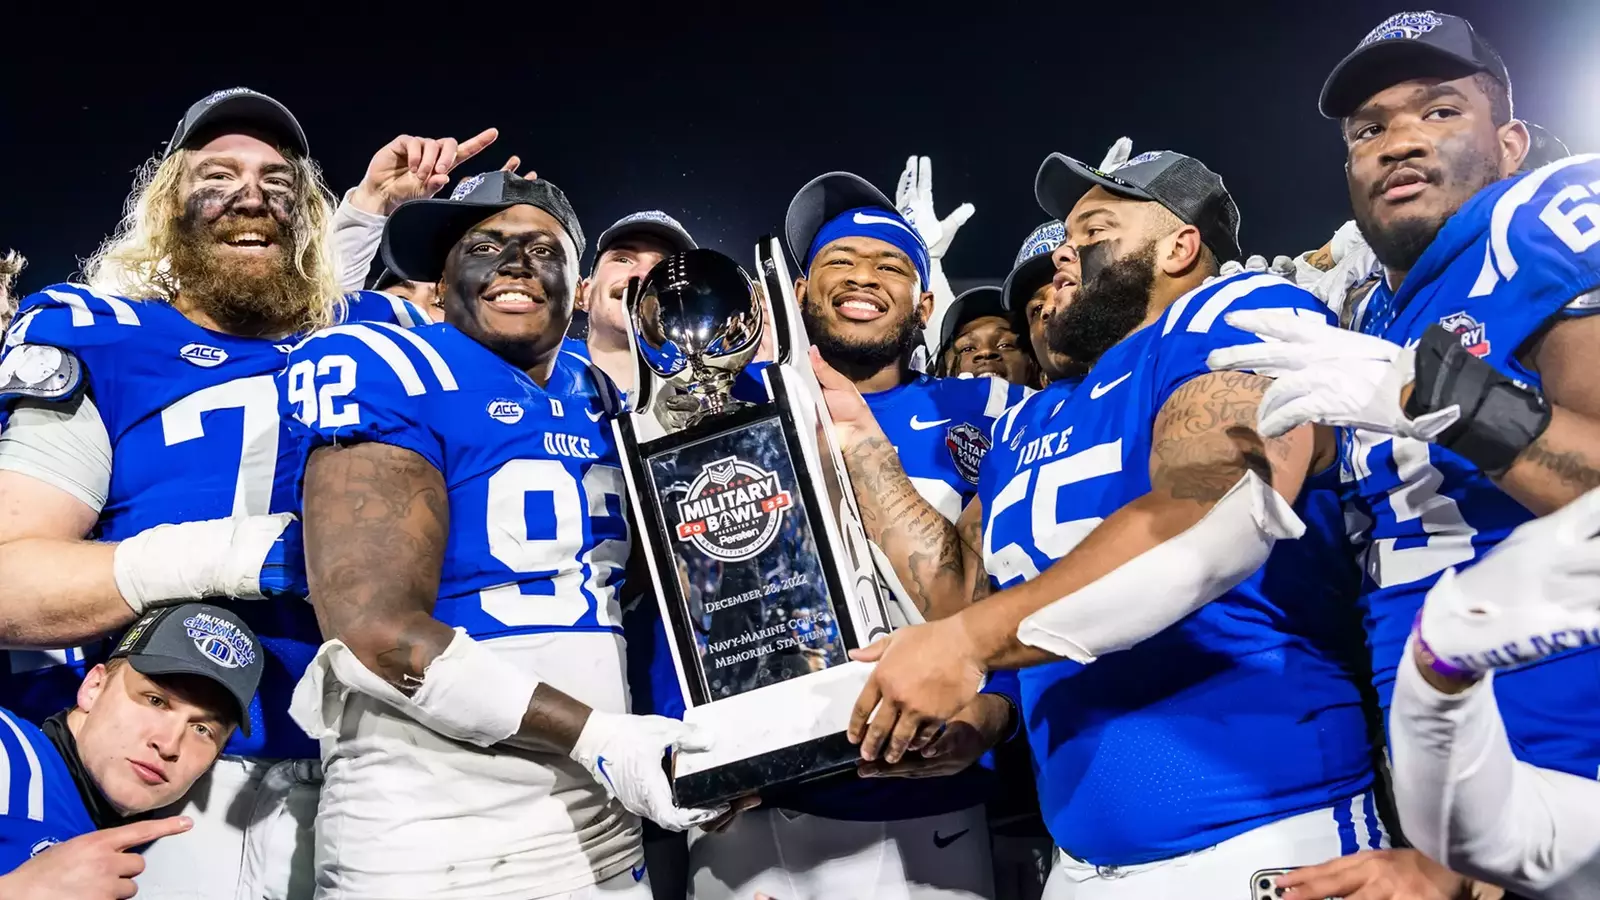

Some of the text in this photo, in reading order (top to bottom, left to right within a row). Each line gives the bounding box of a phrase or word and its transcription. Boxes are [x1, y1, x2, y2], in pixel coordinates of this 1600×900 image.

[1538, 181, 1600, 254] 6
[186, 346, 222, 361] ACC
[288, 354, 361, 429] 92
[492, 403, 519, 417] ACC
[543, 431, 600, 459] DUKE
[950, 431, 987, 458] MILITA
[683, 478, 774, 522] MILITARY
[766, 496, 785, 509] 22
[983, 437, 1123, 586] 55
[683, 523, 702, 534] 20
[714, 522, 750, 537] PRESENTED
[719, 527, 760, 547] Peraton
[479, 458, 632, 628] 92
[780, 574, 808, 590] 2022
[195, 612, 236, 630] MILITARY
[183, 616, 256, 664] CHAMPIONS
[715, 643, 776, 669] MEMORIAL
